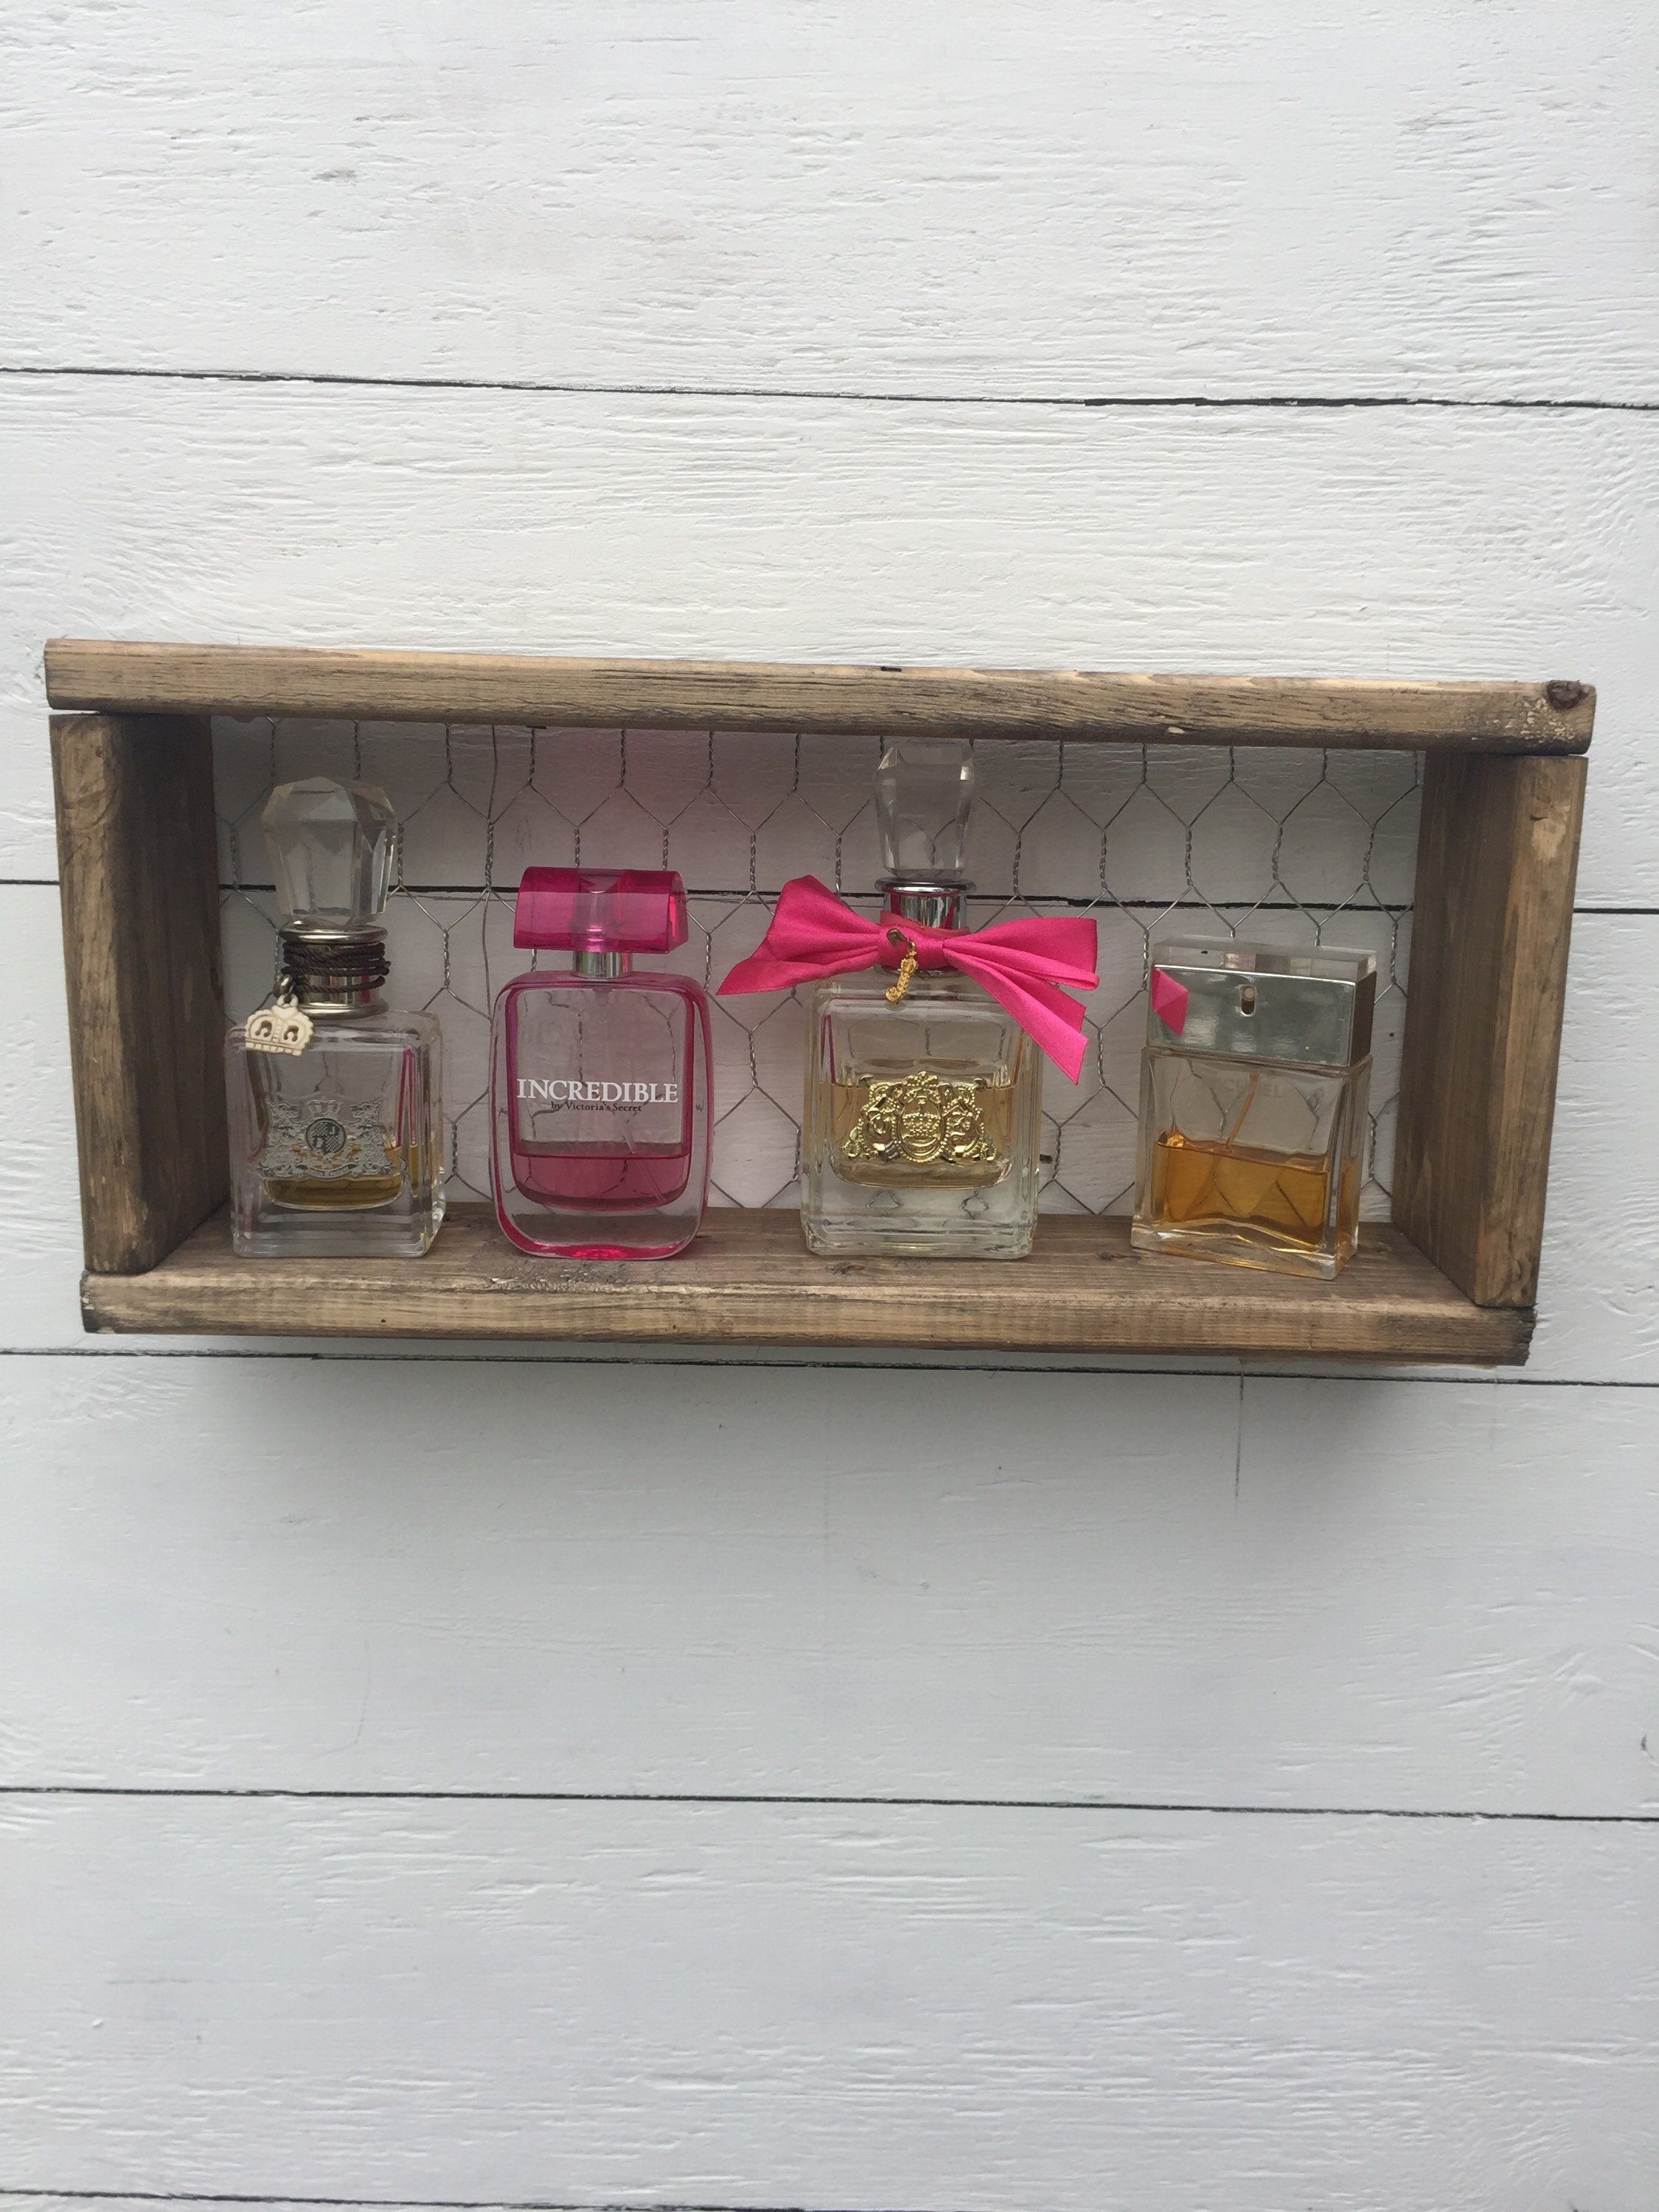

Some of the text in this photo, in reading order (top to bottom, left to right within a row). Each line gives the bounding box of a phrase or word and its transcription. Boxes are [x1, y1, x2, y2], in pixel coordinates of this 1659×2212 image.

[516, 1079, 678, 1103] INCREDIBLE
[551, 1101, 642, 1113] by Victoria's Secret
